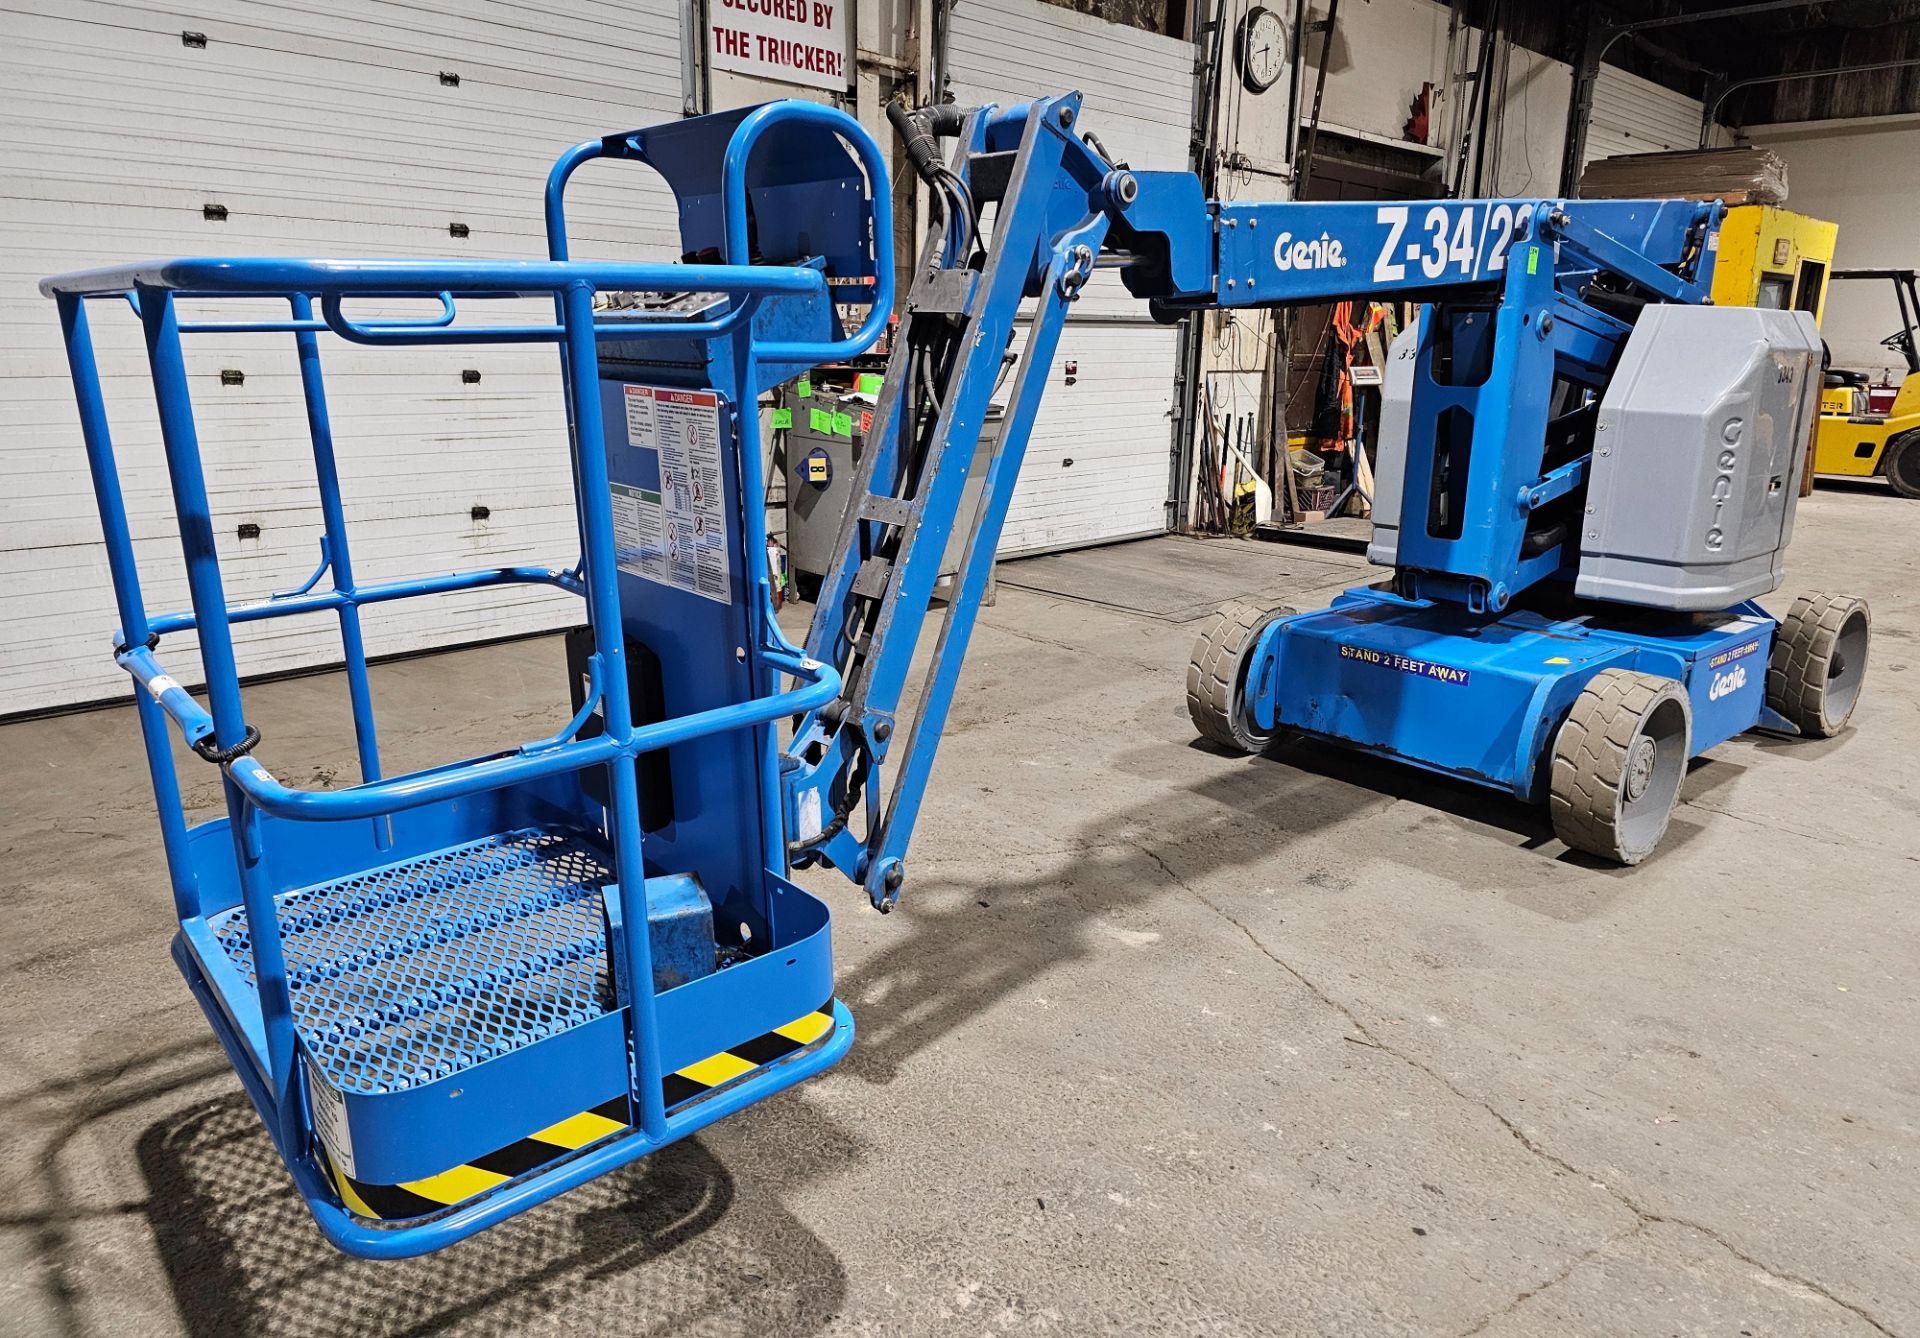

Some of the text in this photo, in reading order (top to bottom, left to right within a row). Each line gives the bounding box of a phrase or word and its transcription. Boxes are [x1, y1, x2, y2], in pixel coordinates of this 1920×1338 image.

[813, 2, 834, 30] BY
[712, 26, 842, 77] THE TRUCKER!
[1373, 202, 1564, 283] Z-34/22
[1704, 416, 1744, 552] Genie
[1341, 646, 1467, 683] STAND 2 FEET AWAY
